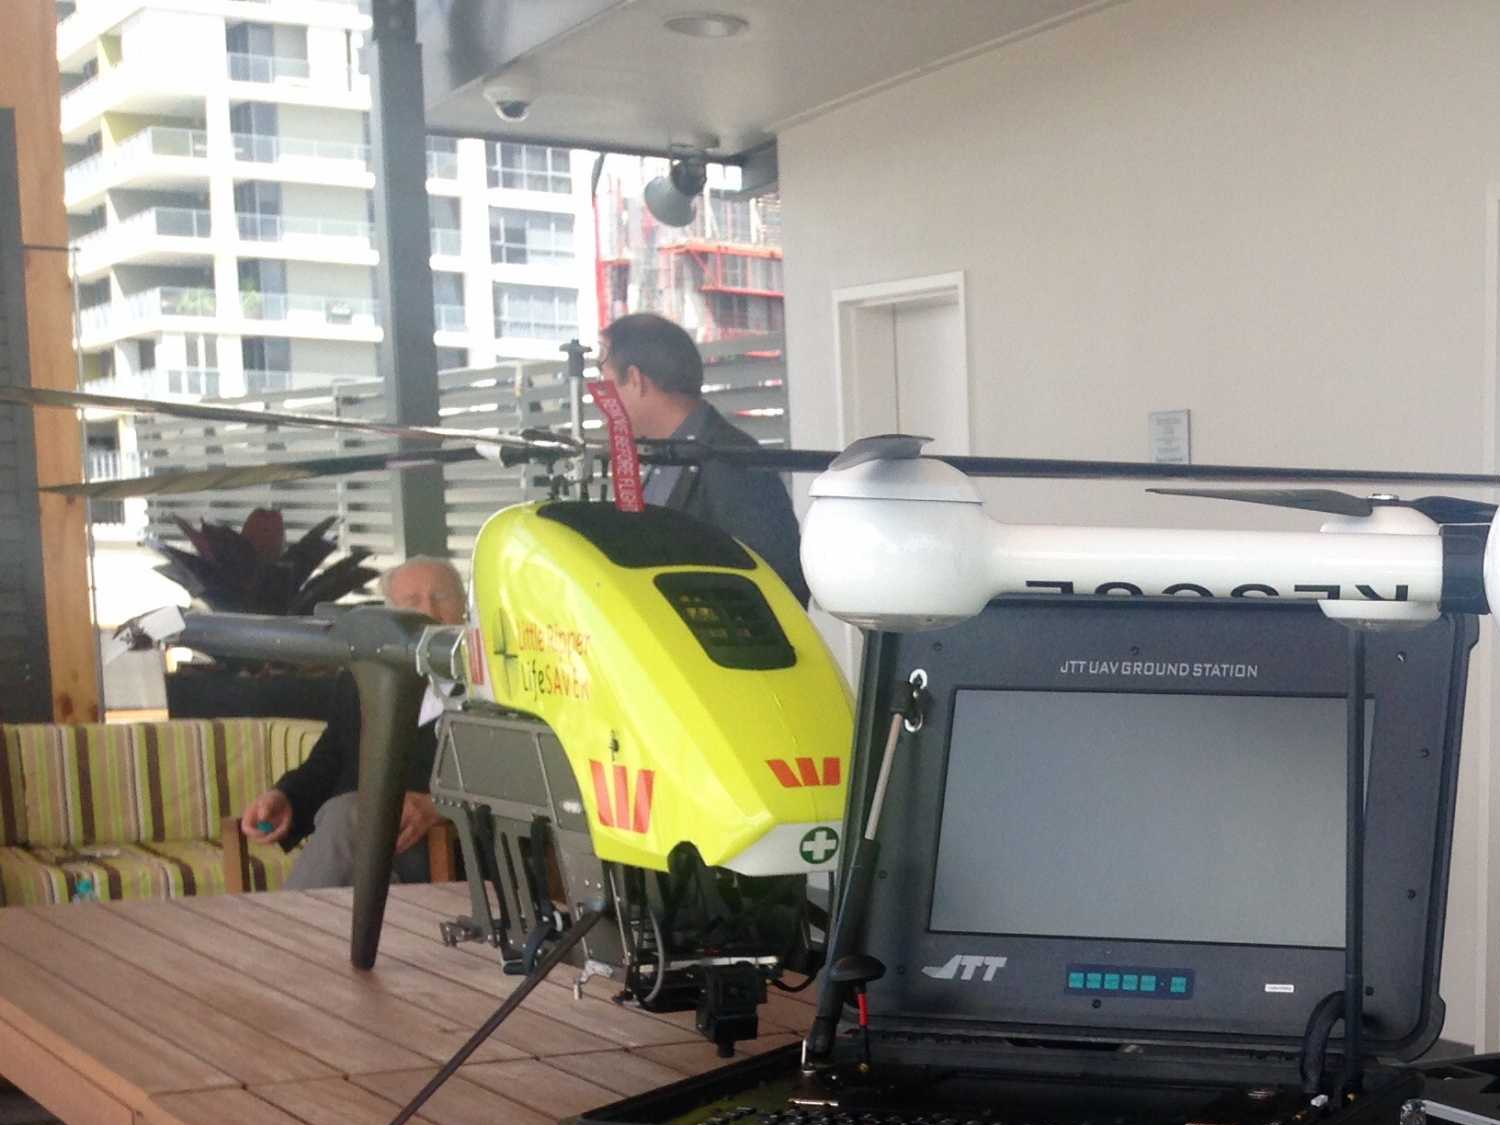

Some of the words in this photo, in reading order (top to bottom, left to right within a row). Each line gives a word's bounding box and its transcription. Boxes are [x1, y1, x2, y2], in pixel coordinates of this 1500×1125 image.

[614, 434, 635, 478] BEFORE
[519, 622, 545, 653] Little
[546, 623, 592, 658] Ripper
[520, 658, 593, 703] LifeSAVER
[1060, 659, 1087, 674] JTT
[1089, 660, 1119, 674] UAV
[1120, 661, 1190, 677] GROUND
[1192, 662, 1259, 678] STATION
